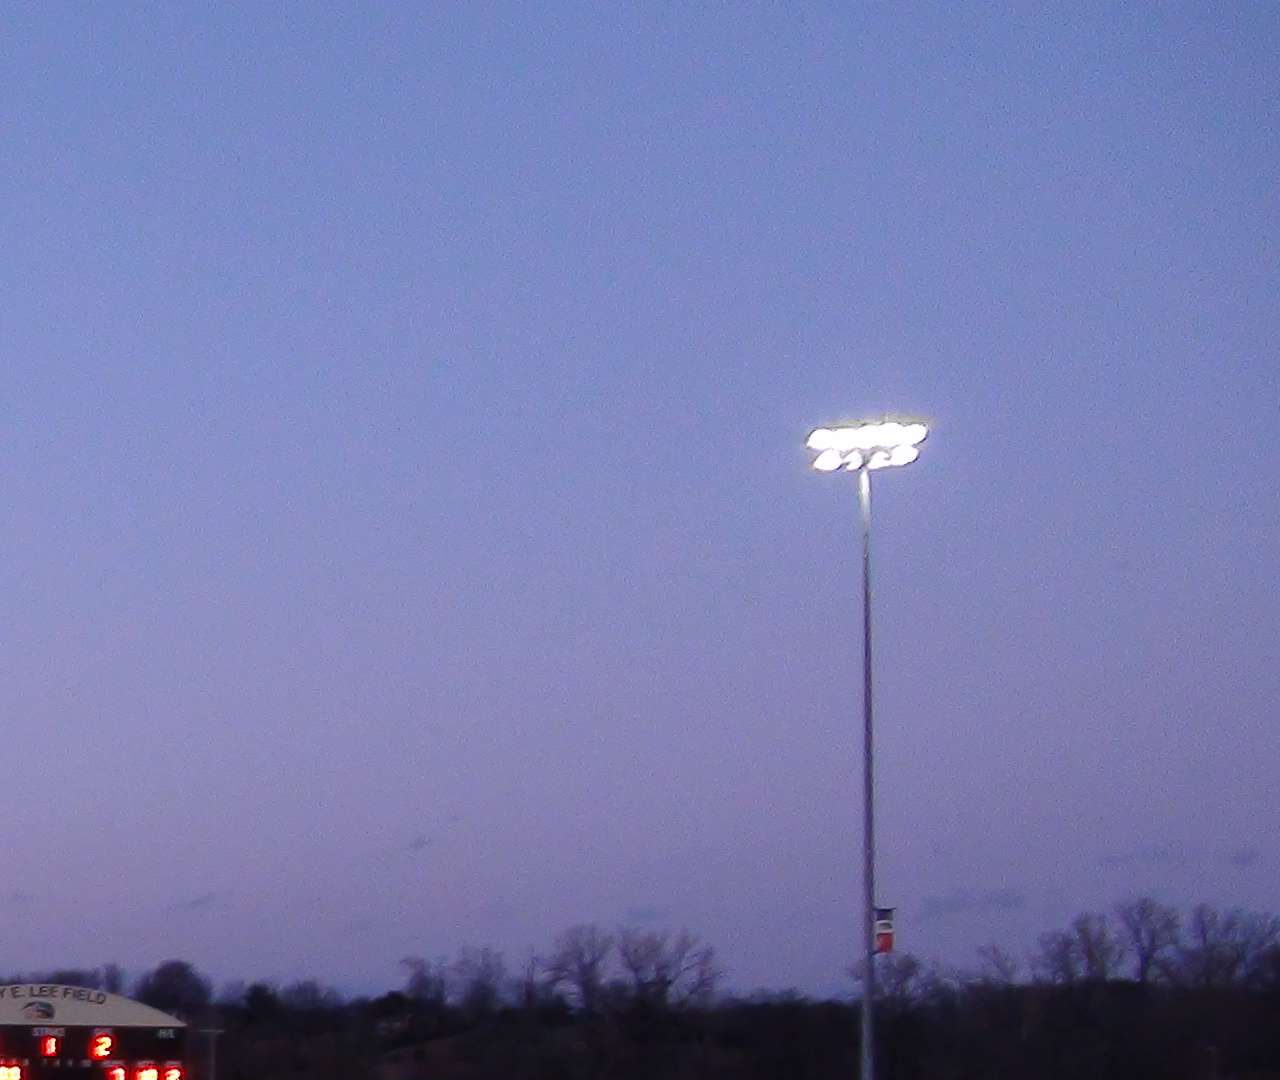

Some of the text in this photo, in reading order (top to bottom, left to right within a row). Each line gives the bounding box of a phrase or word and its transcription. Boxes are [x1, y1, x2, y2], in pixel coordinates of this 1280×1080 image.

[30, 985, 59, 998] LEE
[64, 987, 107, 1004] FIELD
[95, 1036, 113, 1057] 2
